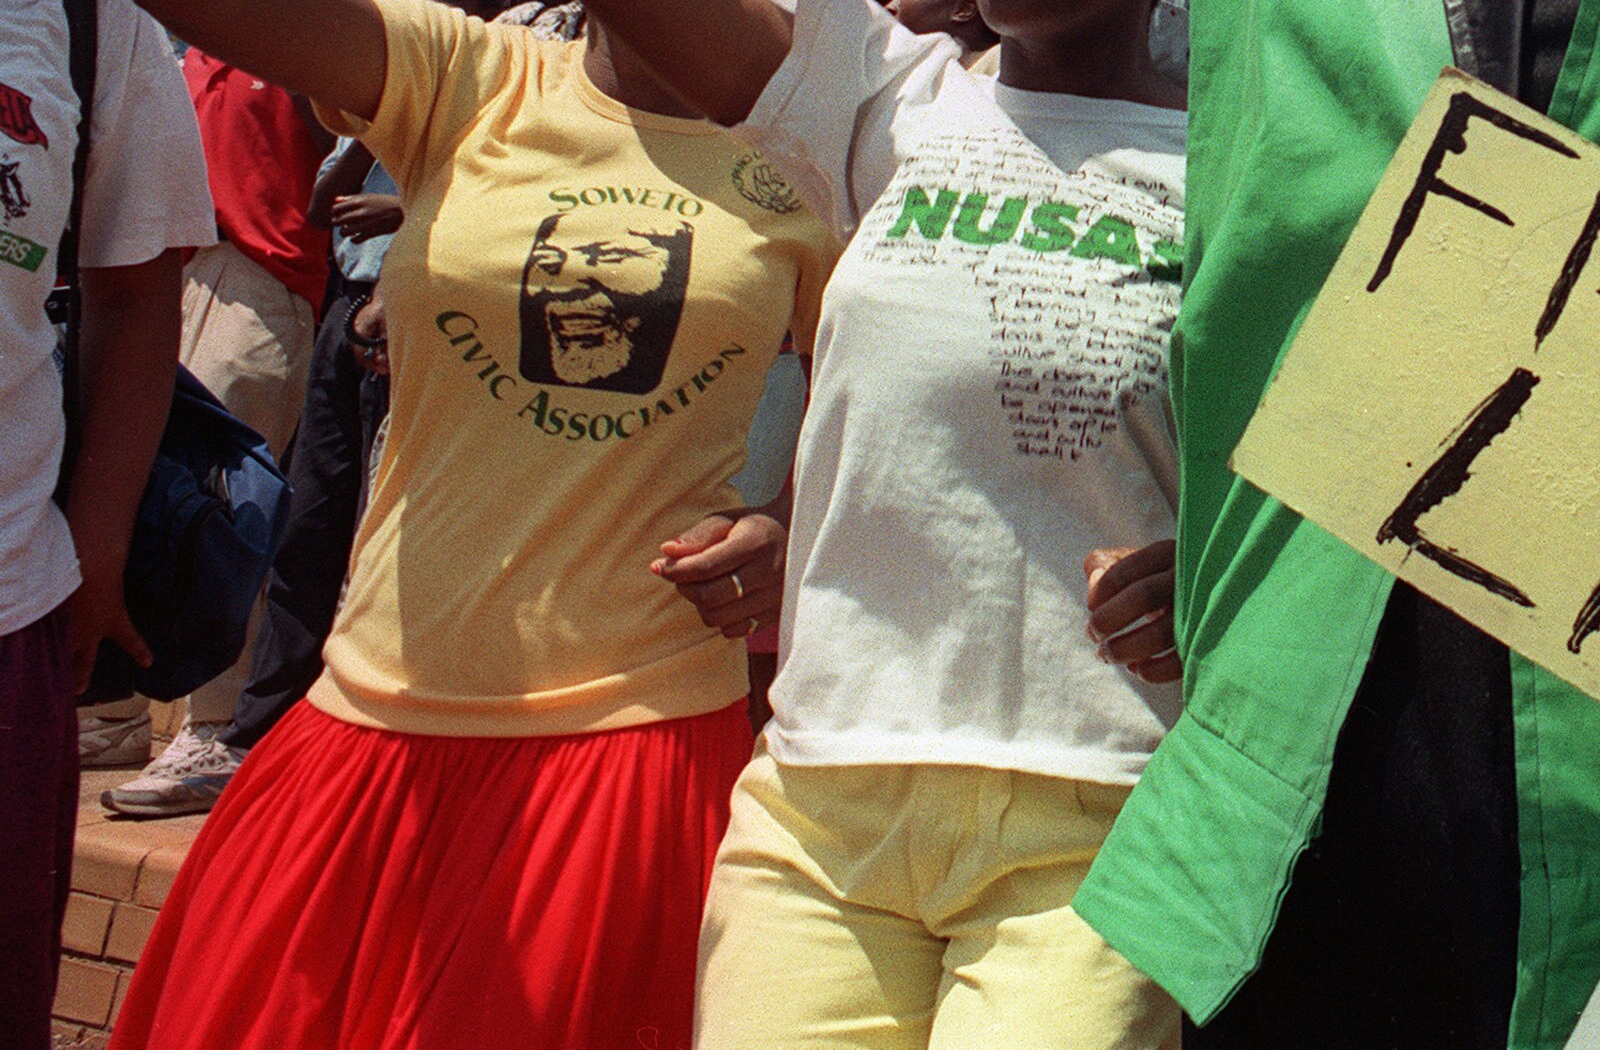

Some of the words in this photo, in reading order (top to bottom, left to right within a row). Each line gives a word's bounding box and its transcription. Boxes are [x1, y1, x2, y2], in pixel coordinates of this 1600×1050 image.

[548, 186, 704, 217] SOWETO
[435, 310, 518, 401] CIVIC
[518, 342, 746, 442] ASSOCIATION
